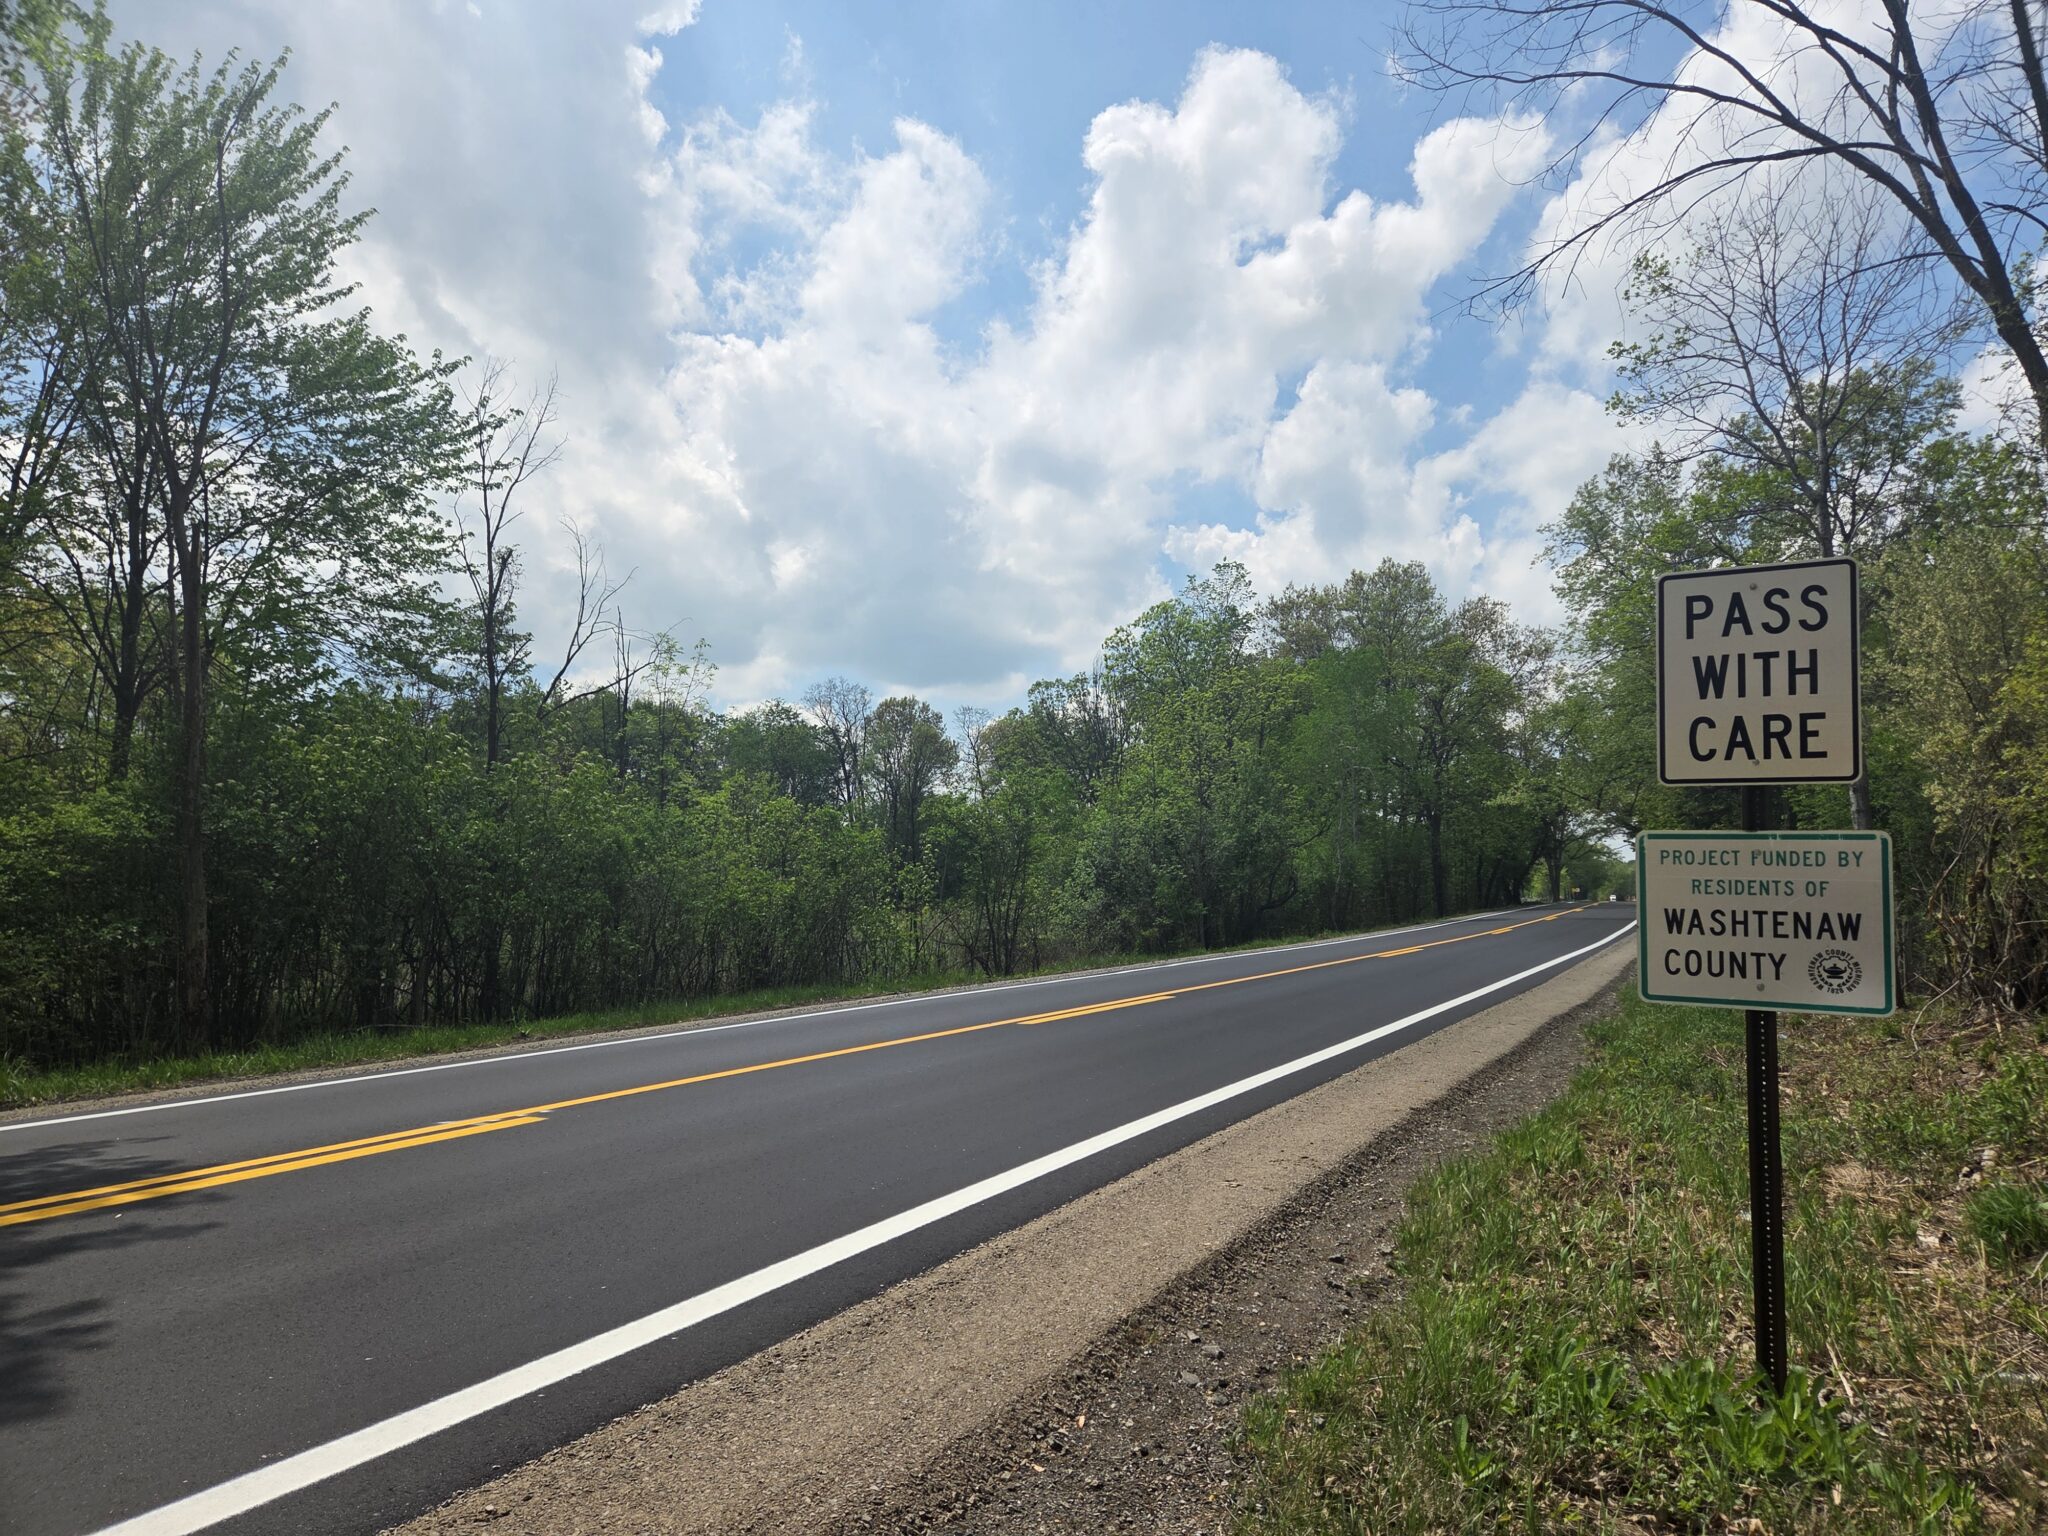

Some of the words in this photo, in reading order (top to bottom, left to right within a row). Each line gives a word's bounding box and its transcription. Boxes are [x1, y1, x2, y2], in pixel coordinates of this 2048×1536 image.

[1686, 584, 1828, 639] PASS
[1692, 649, 1818, 700] WITH
[1689, 712, 1828, 762] CARE
[1660, 850, 1740, 866] PROJECT
[1751, 851, 1826, 867] FUNDED
[1838, 851, 1864, 867] BY
[1692, 879, 1794, 896] RESIDENTS
[1806, 881, 1830, 897] OF
[1664, 908, 1862, 941] WASHTENAW
[1664, 949, 1787, 980] COUNTY
[1808, 952, 1824, 990] WASHTENAW
[1825, 949, 1854, 960] COUNTY
[1846, 962, 1862, 992] MICHIGAN
